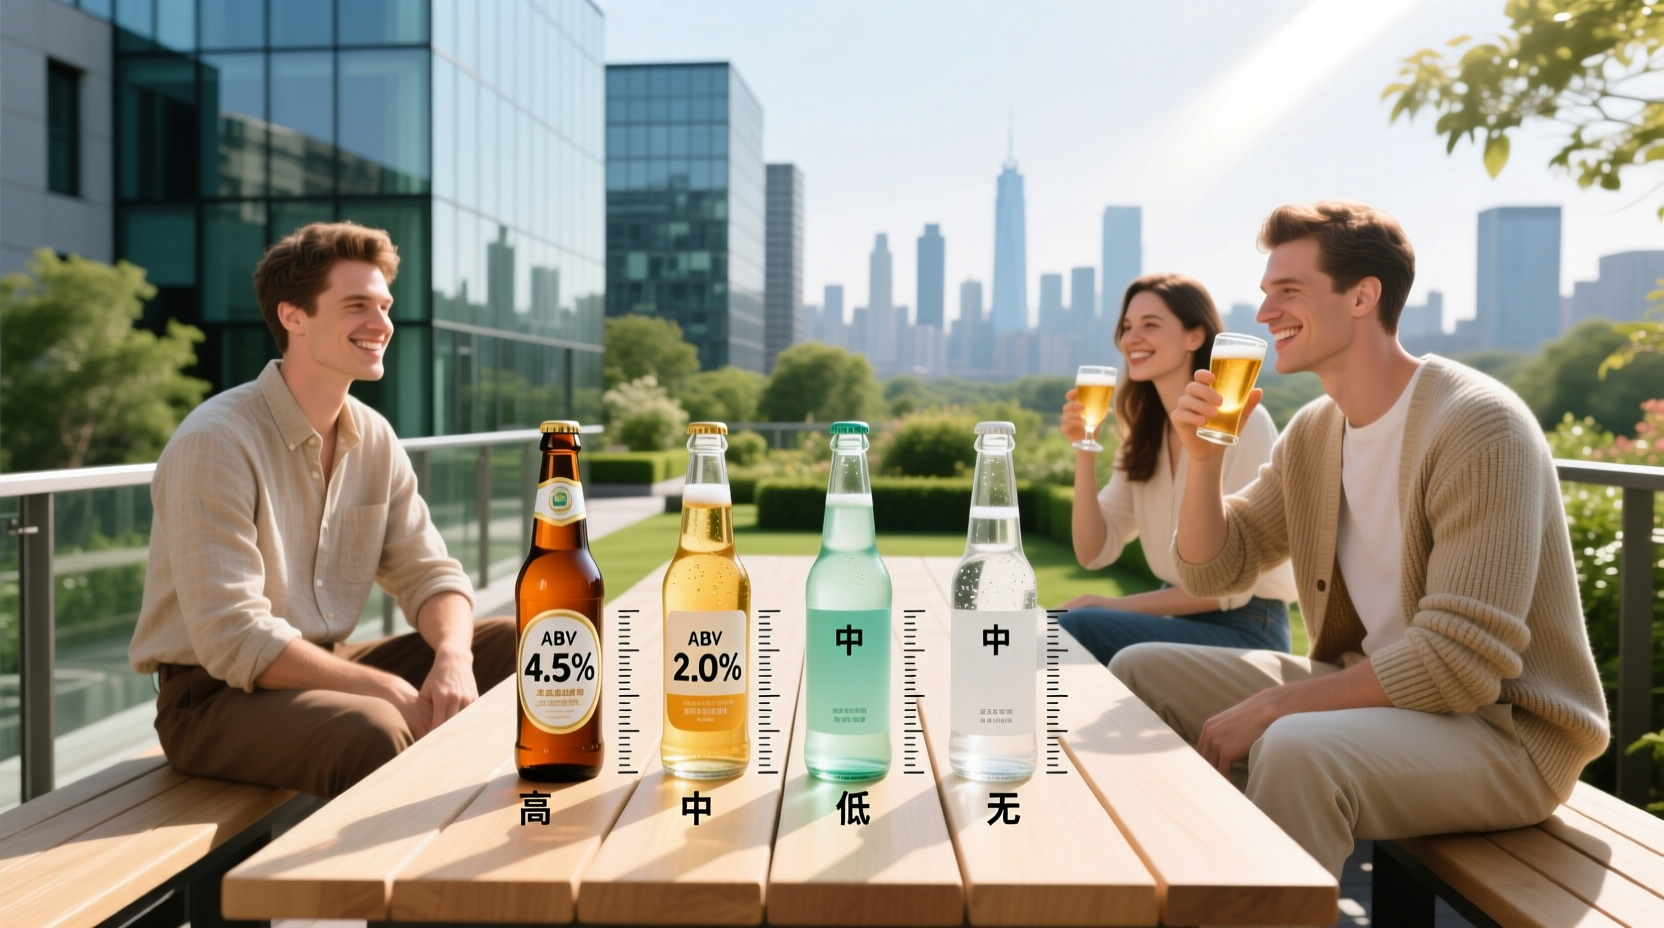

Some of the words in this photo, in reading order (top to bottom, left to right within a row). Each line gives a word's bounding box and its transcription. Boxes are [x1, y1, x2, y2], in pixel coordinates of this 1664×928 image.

[541, 630, 578, 647] ABV
[688, 630, 723, 647] ABV
[835, 623, 863, 657] 中
[982, 623, 1010, 656] 中
[524, 651, 595, 683] 4.5%
[673, 652, 742, 683] 2.0%
